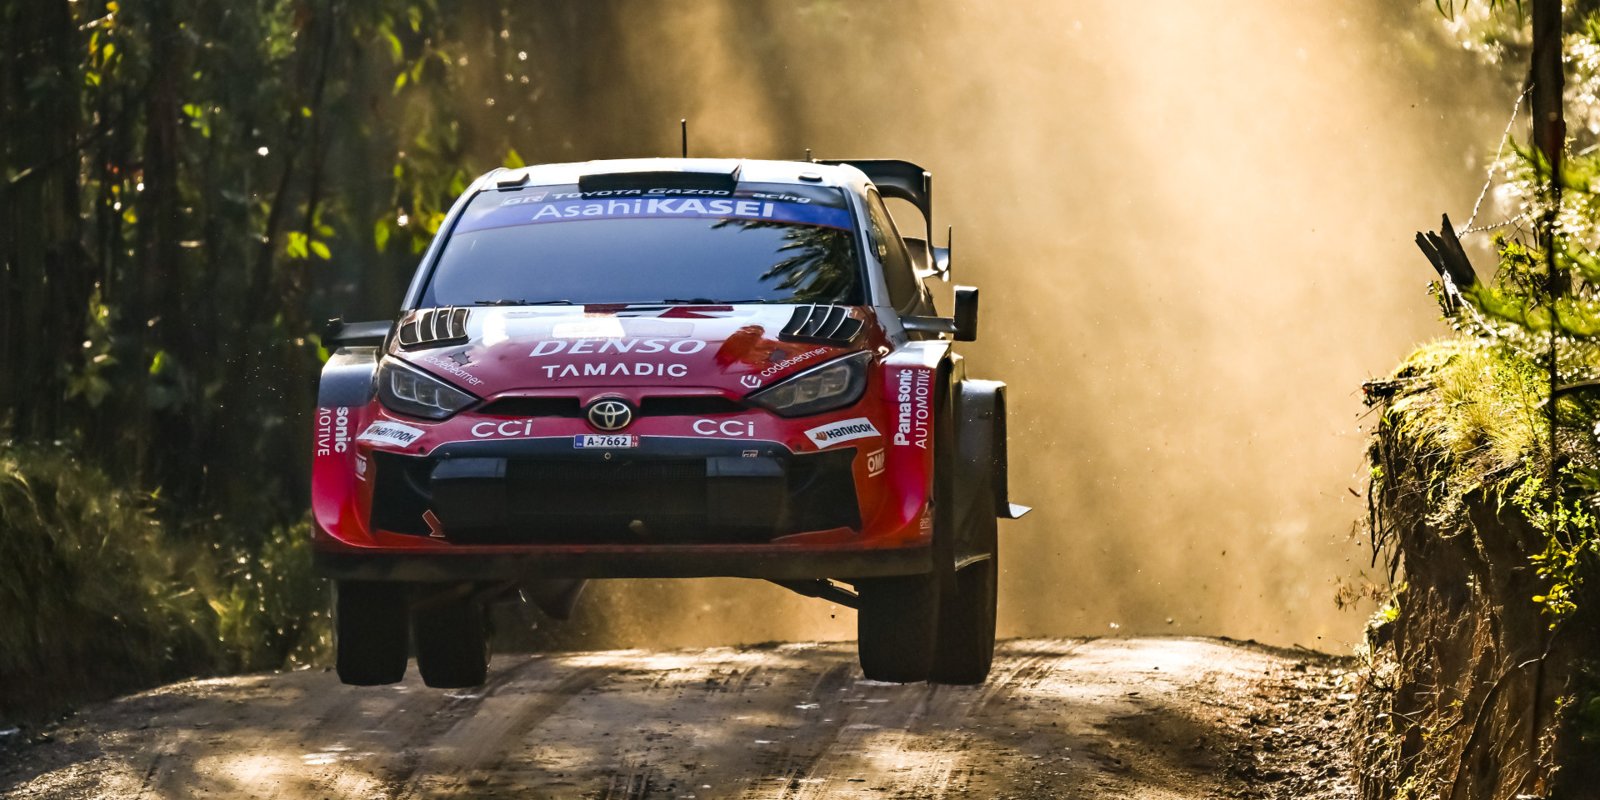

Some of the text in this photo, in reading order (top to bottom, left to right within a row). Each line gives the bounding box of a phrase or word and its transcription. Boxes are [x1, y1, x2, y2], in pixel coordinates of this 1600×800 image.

[552, 189, 641, 199] TOYOTA
[647, 187, 730, 196] GAZOO
[736, 190, 812, 204] acing
[529, 337, 707, 357] DENSO
[424, 355, 485, 386] codebeamer
[542, 363, 688, 378] TAMADIC
[761, 346, 833, 377] codebeamer
[894, 369, 913, 446] Panasonic
[915, 368, 931, 449] AUTOMOTIVE
[335, 406, 351, 453] sonic
[587, 437, 627, 446] A-7662
[867, 453, 885, 473] OMP
